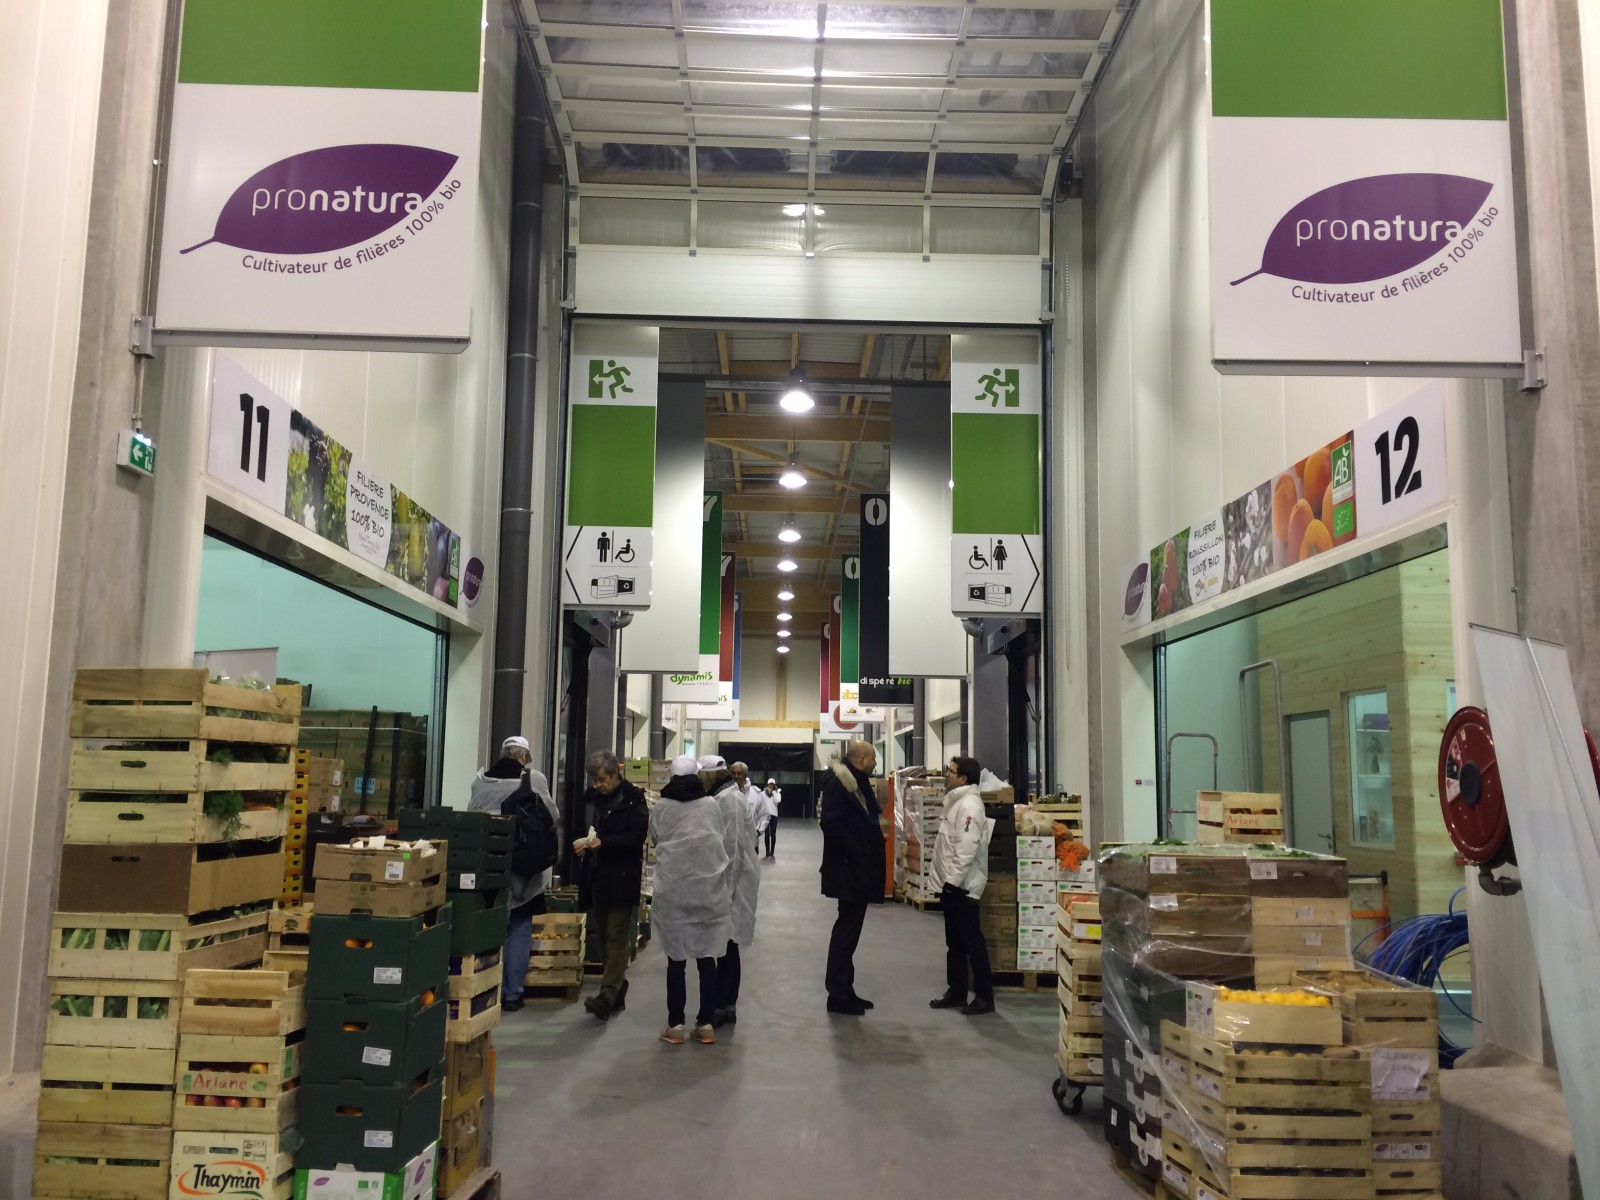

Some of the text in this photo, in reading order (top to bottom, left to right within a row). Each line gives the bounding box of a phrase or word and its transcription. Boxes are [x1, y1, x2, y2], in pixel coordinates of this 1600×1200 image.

[252, 185, 423, 216] pronatura
[242, 178, 461, 275] Cultivateur de filières 100% bio
[1296, 214, 1463, 247] pronatura
[1291, 206, 1499, 303] Cultivateur de filières 100% bio
[239, 393, 270, 483] 11
[1333, 456, 1349, 488] AB
[1375, 416, 1422, 505] 12
[350, 484, 389, 520] PROVENCE
[352, 510, 385, 538] 100% BIO
[1188, 535, 1224, 559] ROUSSILLON
[1208, 554, 1220, 568] BIO
[192, 1073, 247, 1090] Ariane
[193, 1163, 261, 1194] Thaymin
